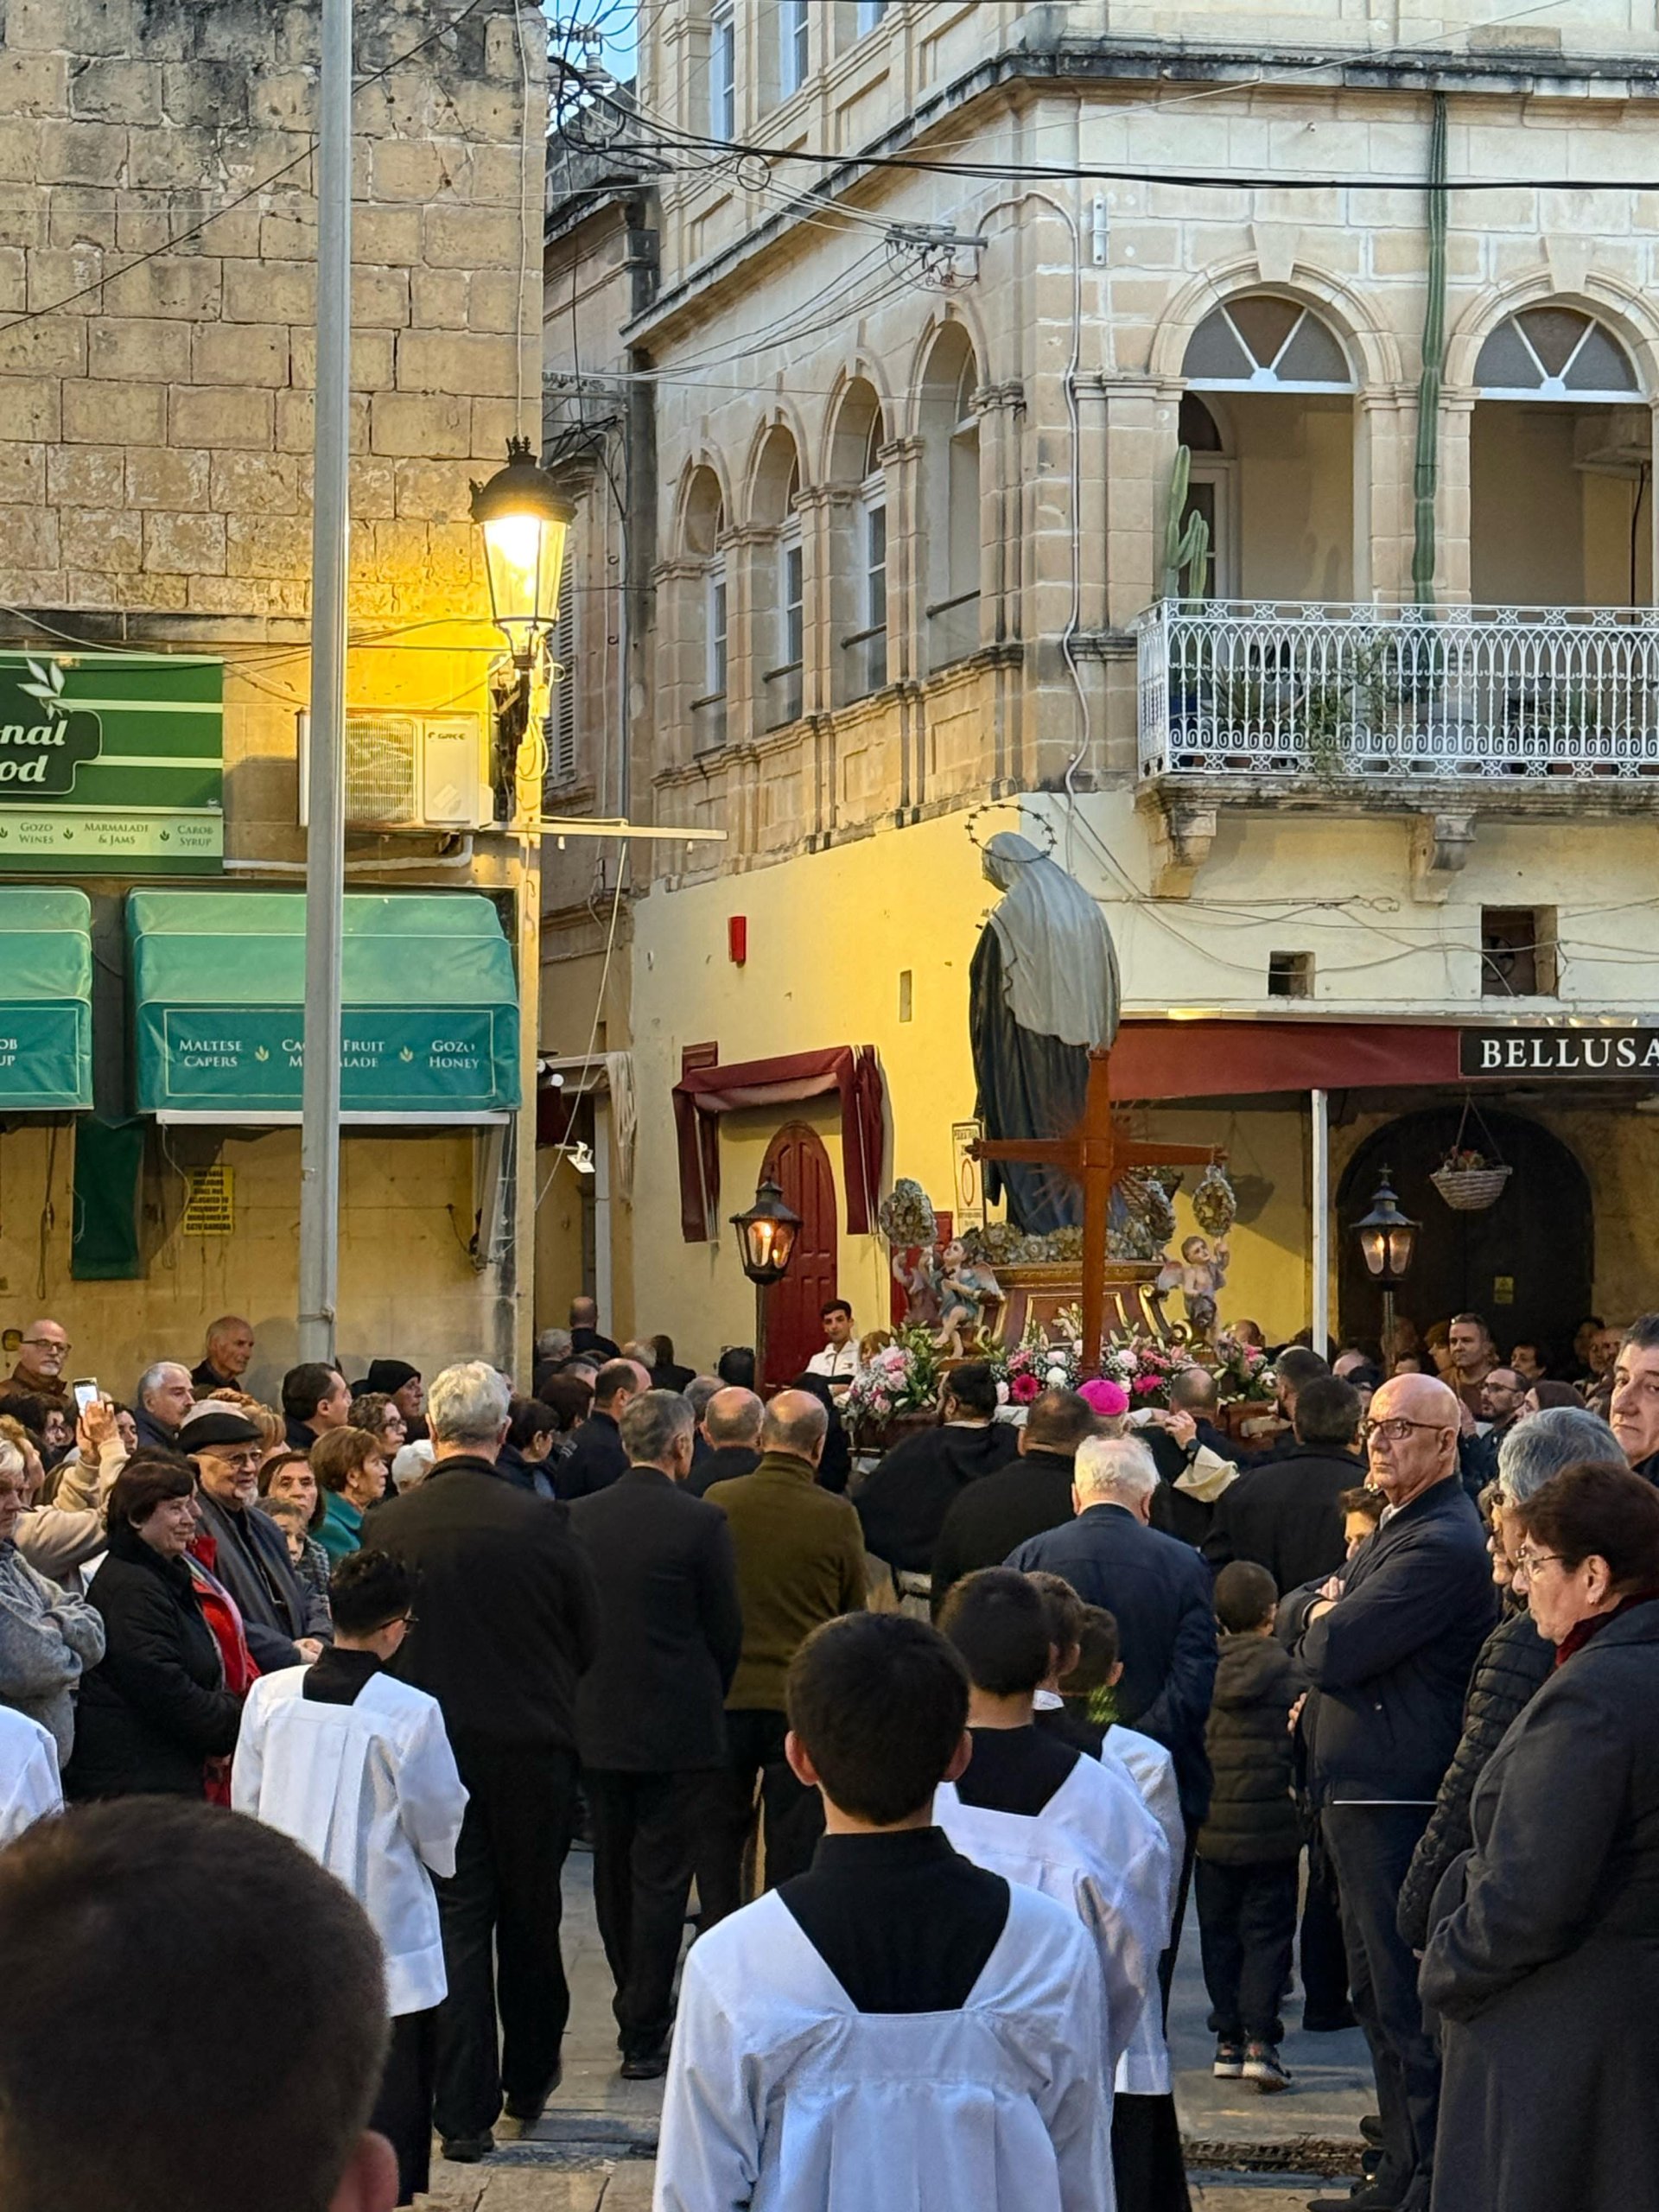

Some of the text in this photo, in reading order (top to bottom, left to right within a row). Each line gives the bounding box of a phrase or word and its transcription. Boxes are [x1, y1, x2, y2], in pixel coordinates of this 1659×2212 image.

[0, 720, 68, 746] nal
[19, 822, 54, 832] GOZO
[19, 834, 54, 844] WINES
[109, 835, 137, 846] JAMS
[179, 836, 212, 847] SYRUP
[179, 1039, 242, 1052] MALTESE
[342, 1039, 385, 1052] FRUIT
[184, 1056, 238, 1067] CAPERS
[429, 1056, 480, 1069] HONEY
